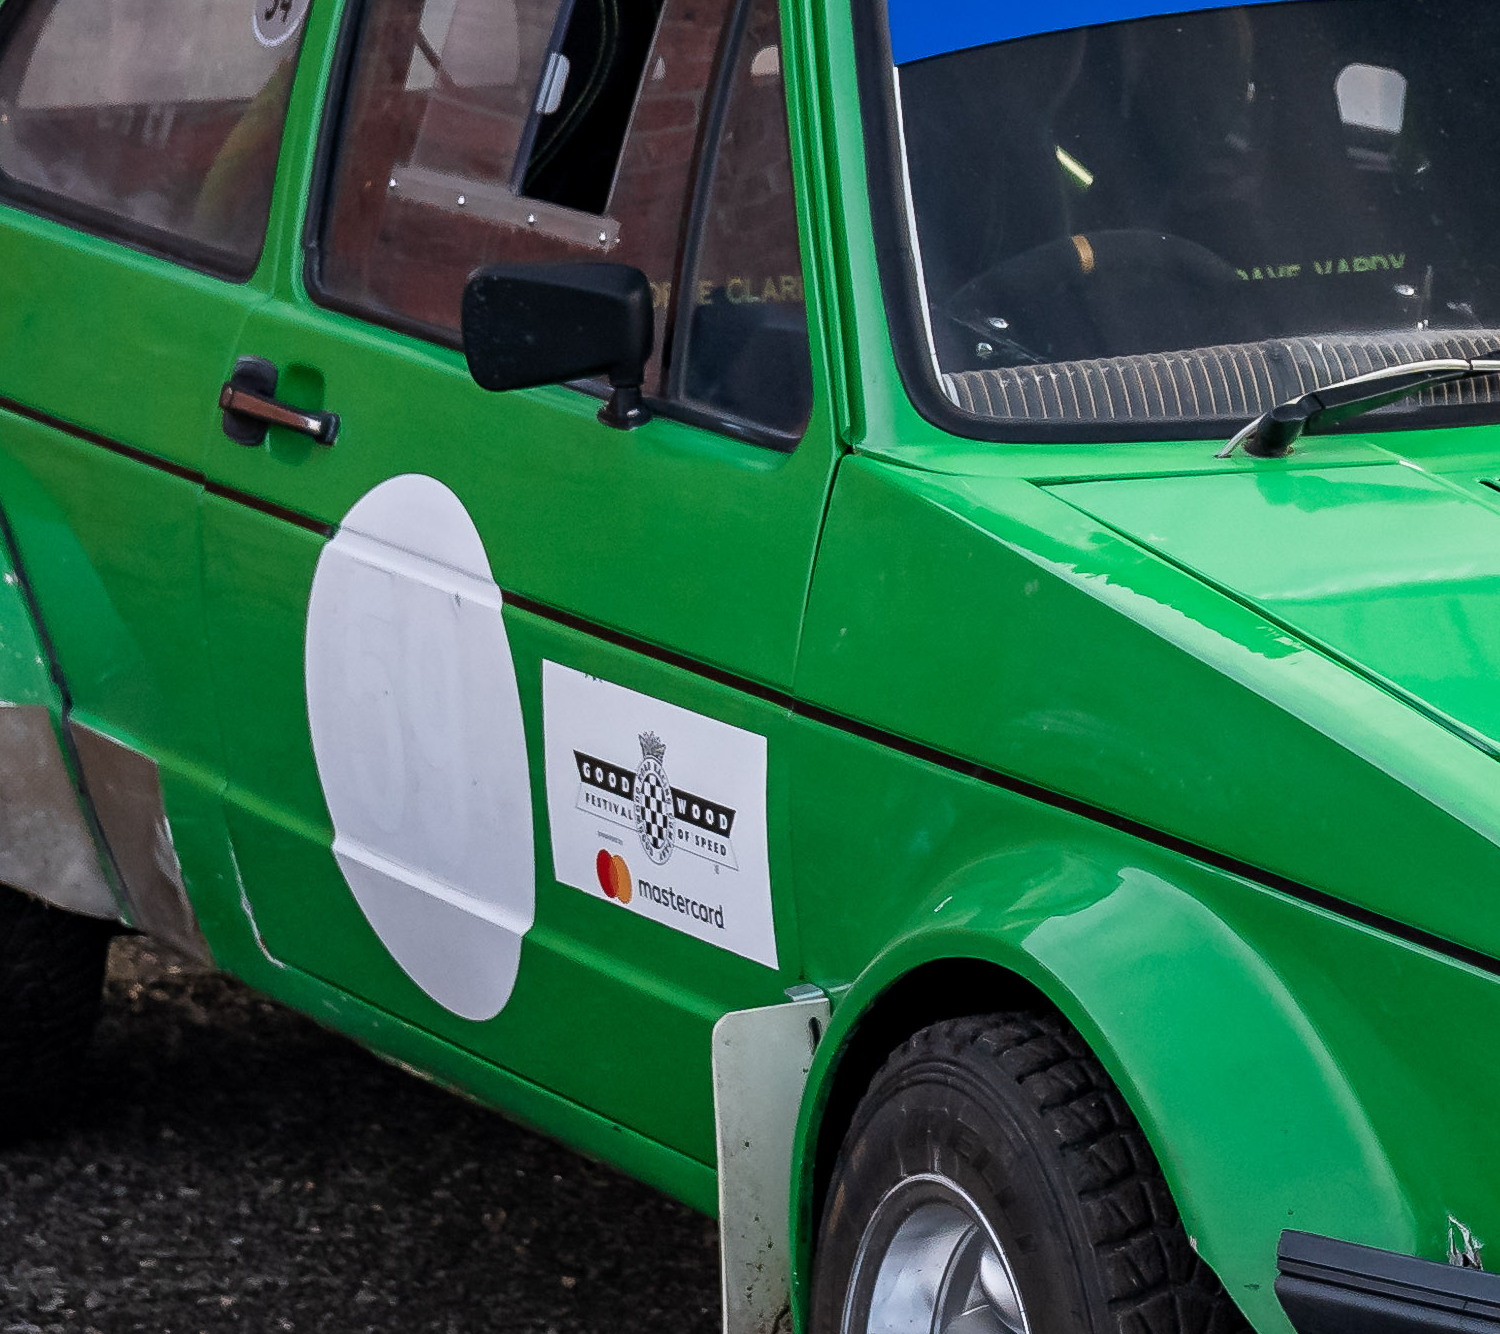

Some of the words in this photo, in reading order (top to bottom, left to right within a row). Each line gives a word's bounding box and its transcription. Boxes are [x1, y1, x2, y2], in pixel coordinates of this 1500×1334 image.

[725, 275, 803, 305] CLAR
[581, 761, 631, 793] GOOD
[676, 797, 729, 831] WOOD
[584, 791, 634, 821] FESTIVAL
[676, 827, 692, 842] OF
[694, 833, 727, 857] SPEED
[637, 877, 727, 931] mastercard
